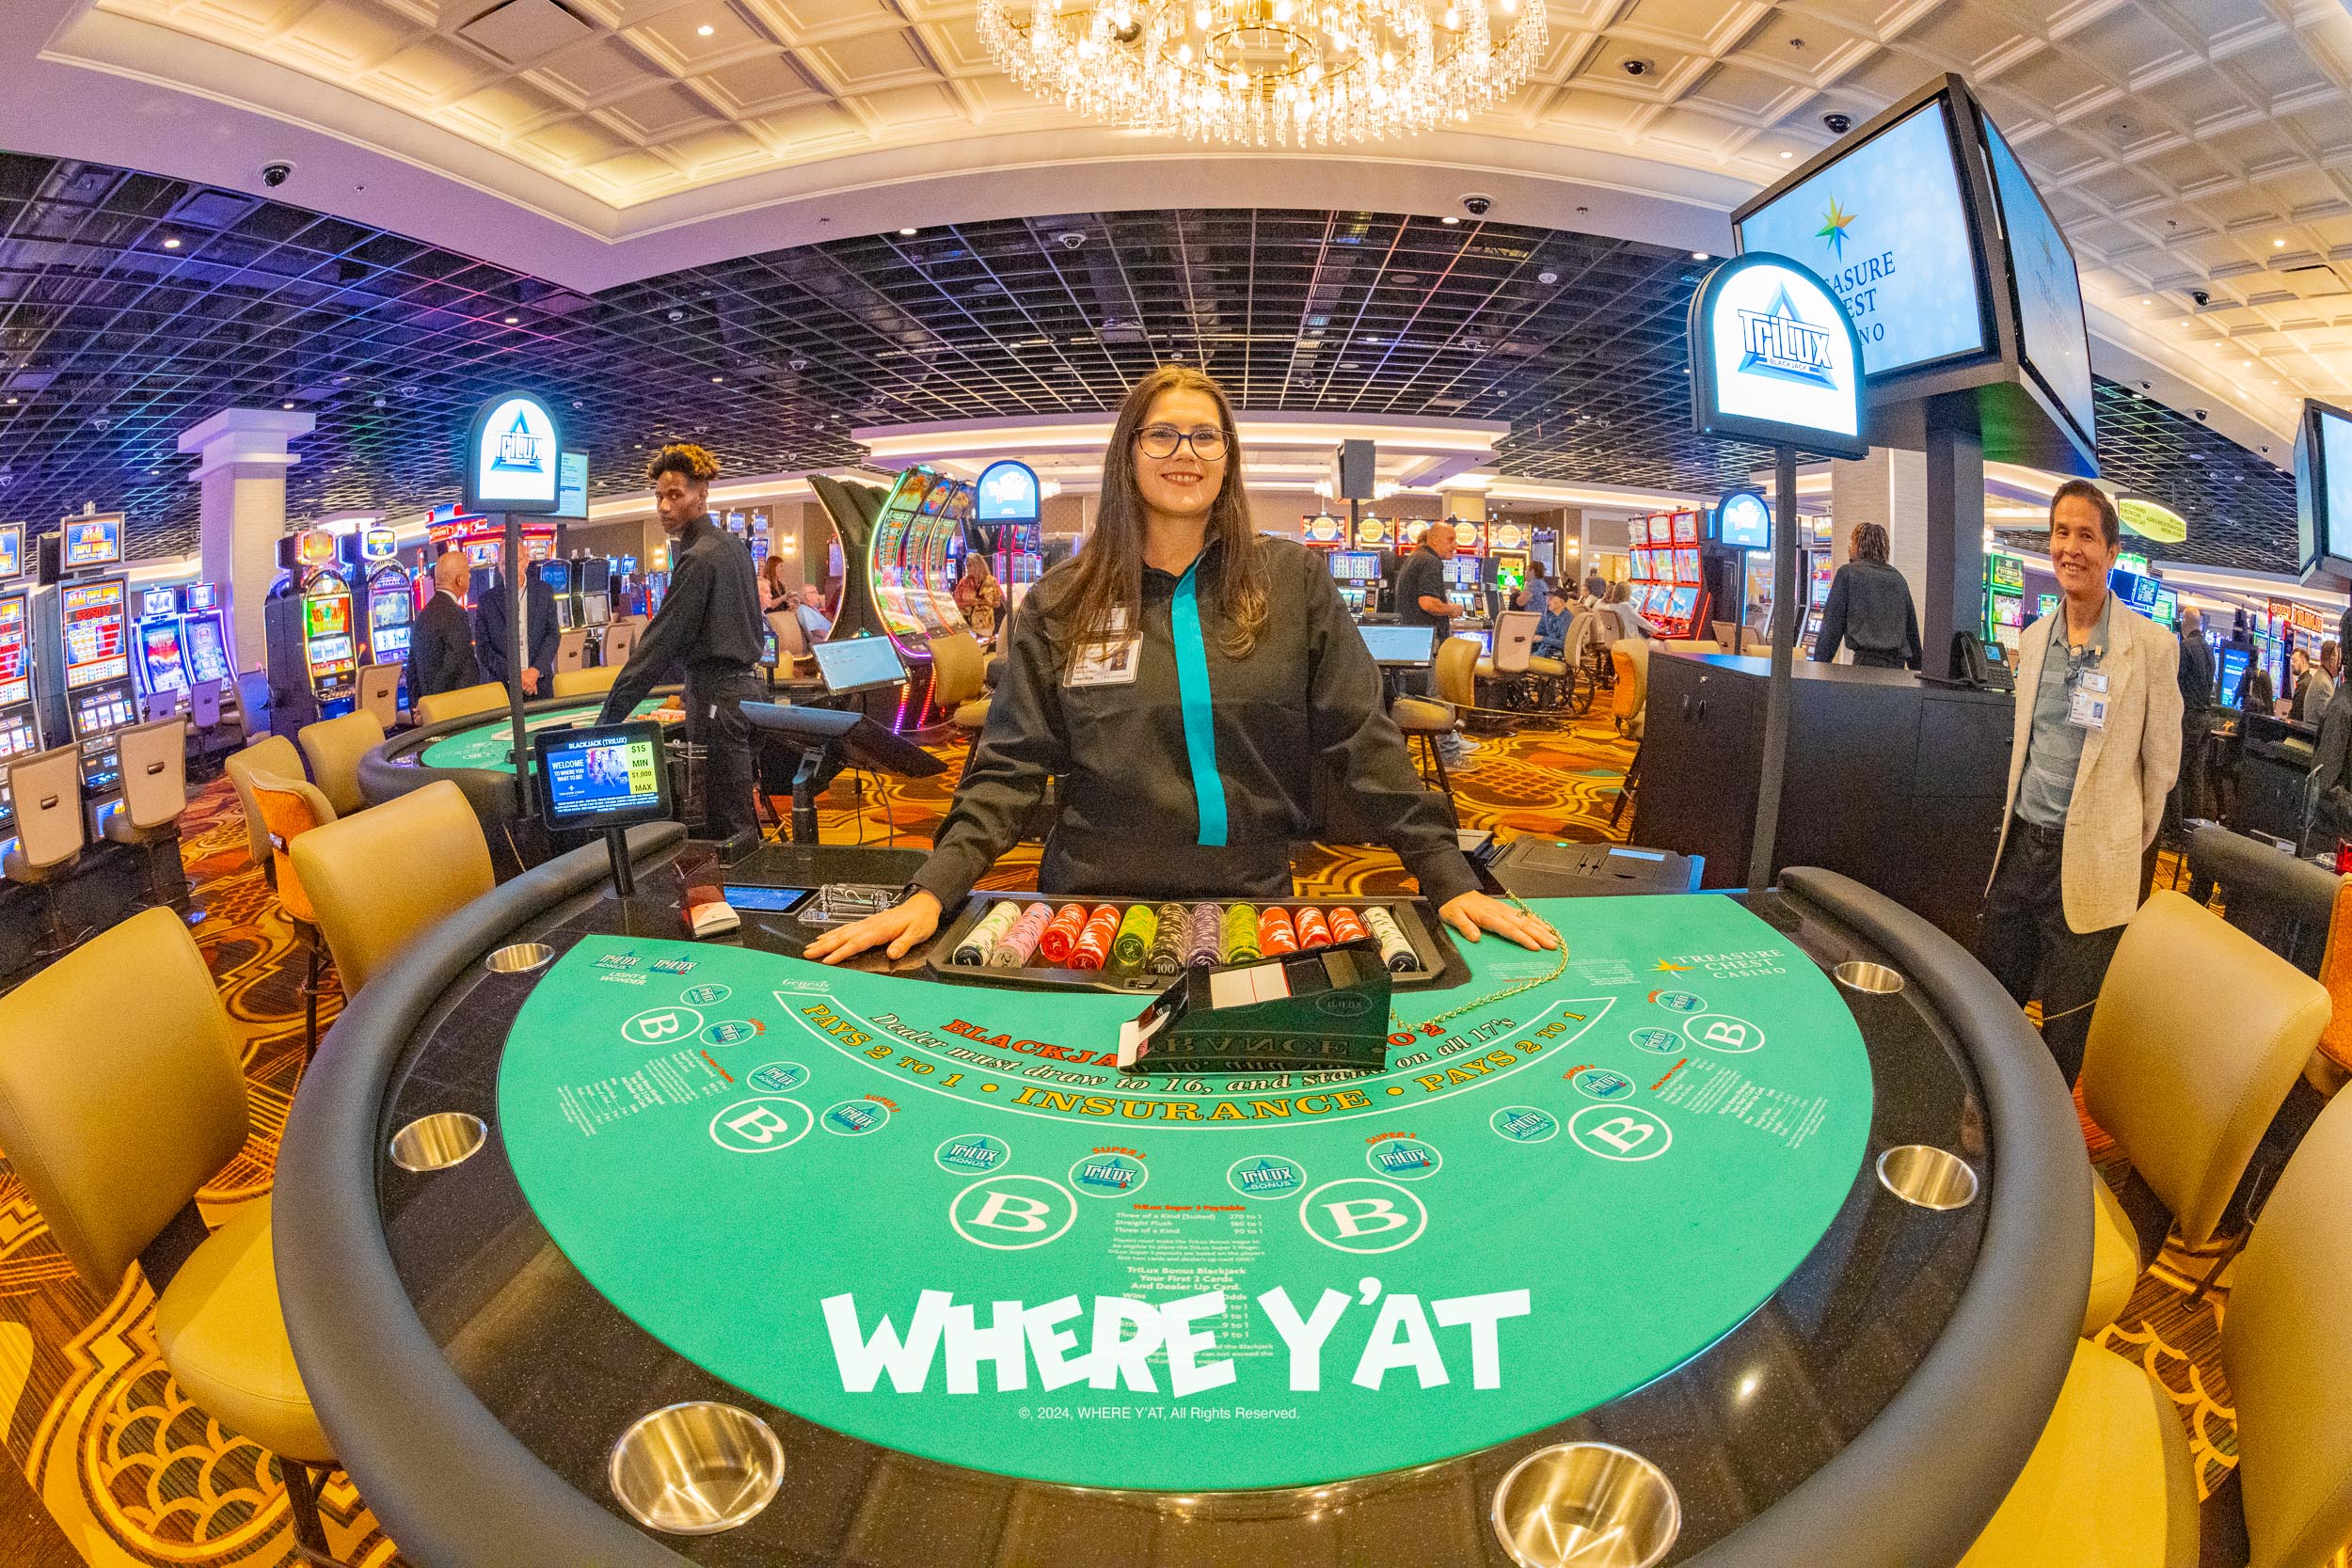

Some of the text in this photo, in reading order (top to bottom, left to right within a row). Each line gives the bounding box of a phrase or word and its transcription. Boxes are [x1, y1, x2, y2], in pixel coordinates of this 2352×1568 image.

[1824, 251, 1896, 294] ASURE
[1843, 289, 1876, 318] EST
[569, 736, 627, 749] BLACKJACK (TRILUX)
[552, 759, 584, 769] WELCOME
[632, 759, 648, 768] MIN
[635, 784, 652, 792] MAX
[1673, 949, 1785, 964] TREASURE
[1704, 959, 1774, 973] CHEST
[600, 976, 647, 986] WONDER
[1712, 967, 1787, 979] CASINO
[638, 1012, 679, 1038] B
[941, 1019, 1118, 1068] BLACKJA
[1704, 1022, 1747, 1048] B
[801, 1003, 1587, 1121] PAYS 2 TO 1 INSURANCE PAYS 2 TO 1
[869, 1012, 949, 1051] Dealer
[946, 1046, 1023, 1072] must
[1024, 1065, 1108, 1086] draw
[1115, 1076, 1151, 1092] to
[1159, 1077, 1214, 1095] 16,
[1226, 1073, 1292, 1093] and
[1395, 1053, 1432, 1069] on
[1438, 1036, 1470, 1056] all
[1470, 1016, 1517, 1043] 17's
[723, 1104, 788, 1145] B
[1502, 1112, 1545, 1133] TriLux
[1366, 1132, 1406, 1144] SUPER
[1585, 1117, 1655, 1155] B
[949, 1143, 1000, 1163] TriLux
[1091, 1146, 1137, 1156] SUPER
[1376, 1148, 1430, 1167] TriLux
[949, 1157, 987, 1167] BONUS
[1083, 1164, 1136, 1183] TriLux
[1240, 1165, 1294, 1183] TriLux
[1250, 1180, 1292, 1190] BONUS
[964, 1190, 1050, 1232] B
[1320, 1198, 1408, 1239] B
[1197, 1268, 1247, 1276] Blackjack
